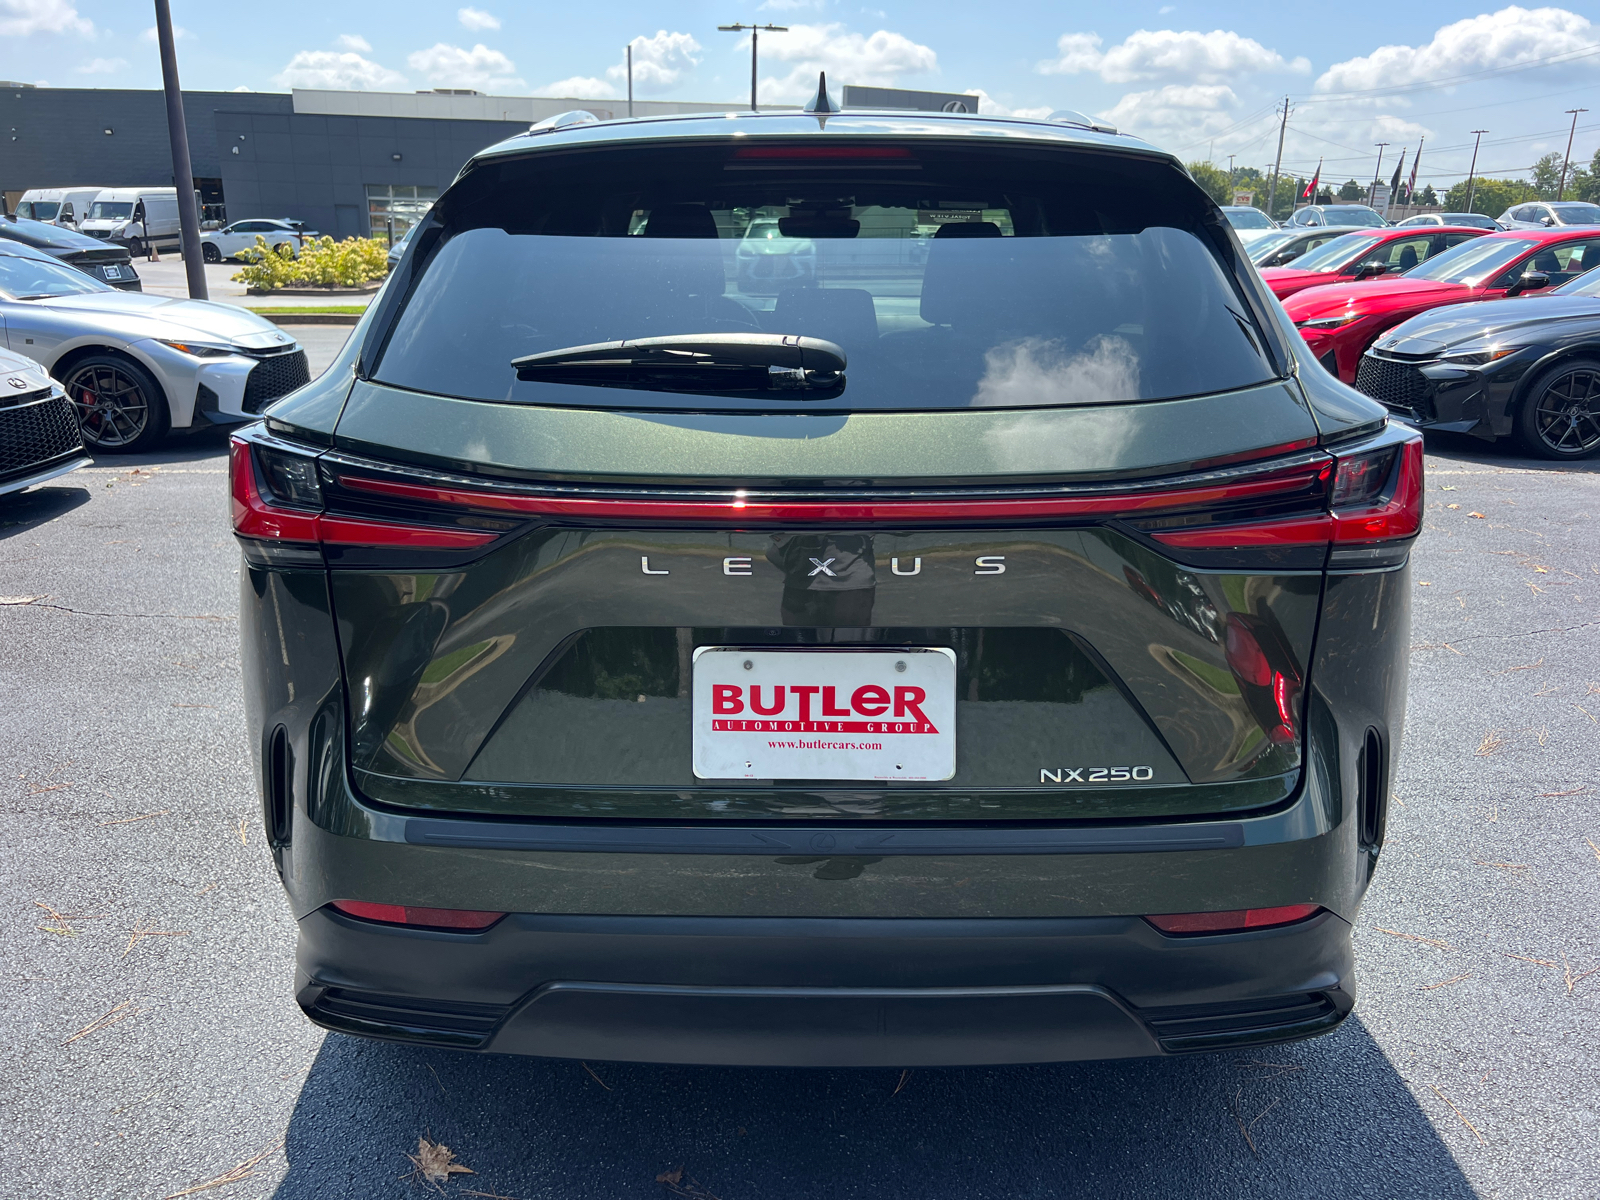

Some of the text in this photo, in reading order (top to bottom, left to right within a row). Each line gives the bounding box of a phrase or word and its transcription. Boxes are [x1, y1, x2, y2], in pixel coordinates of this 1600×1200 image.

[640, 555, 1006, 577] LEXUS
[713, 720, 932, 733] AUTOMOTIVE GROUP
[768, 739, 882, 751] www.butlercars.com
